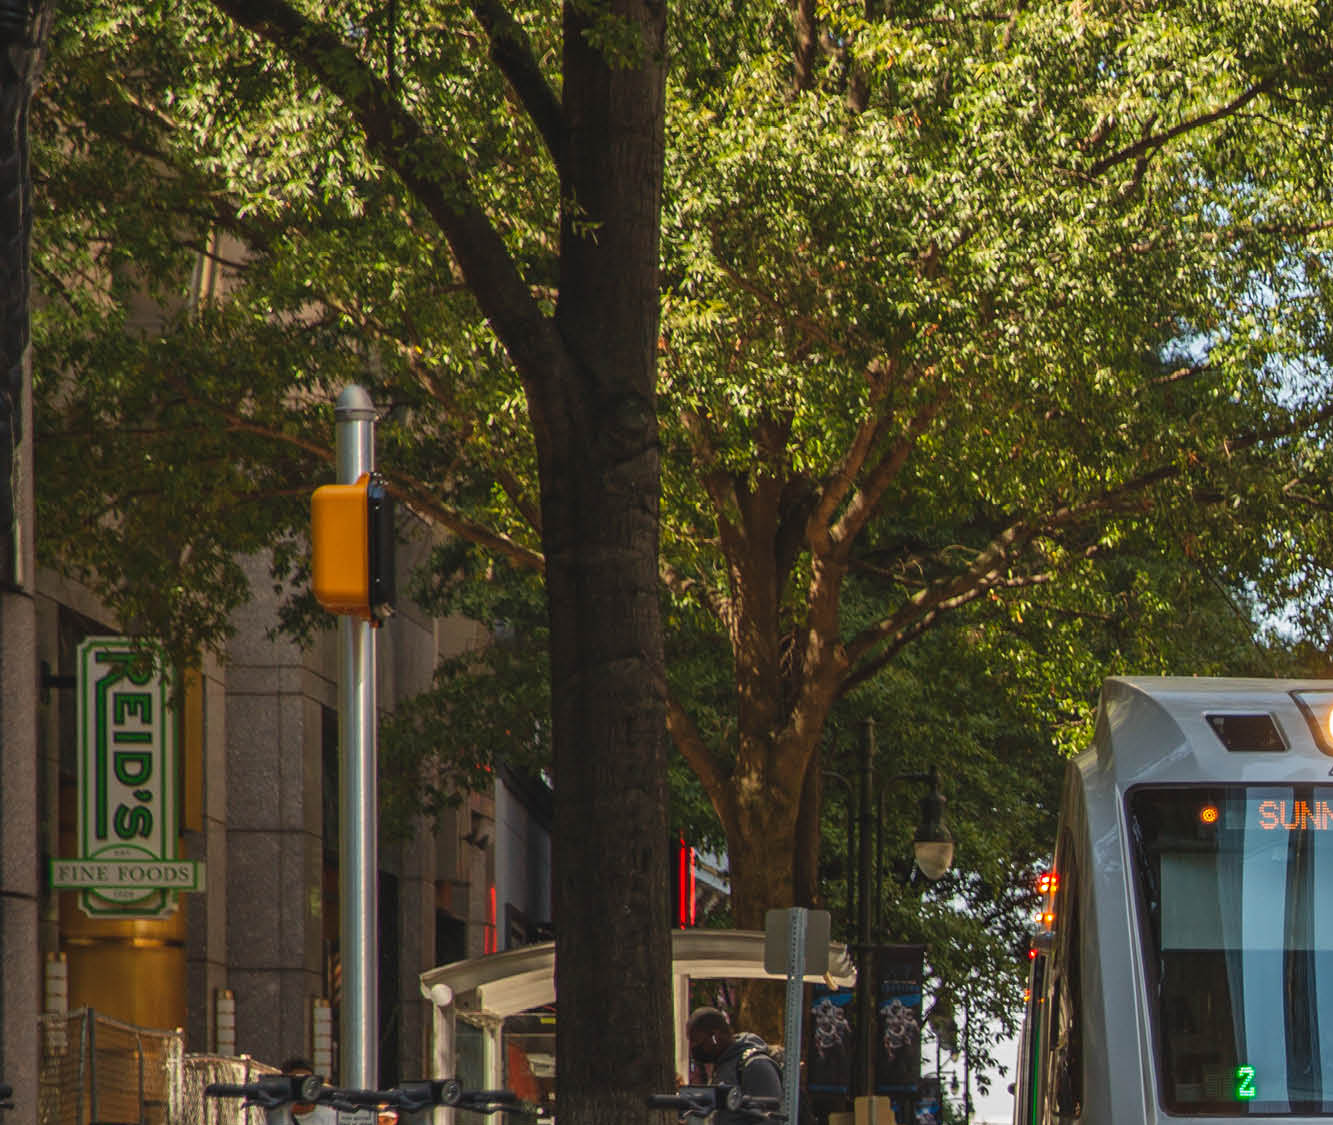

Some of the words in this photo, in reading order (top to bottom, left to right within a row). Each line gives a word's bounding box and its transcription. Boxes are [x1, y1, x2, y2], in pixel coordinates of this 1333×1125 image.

[96, 651, 153, 840] REID'S
[59, 866, 109, 882] FINE
[118, 866, 189, 882] FOODS
[1239, 1066, 1255, 1097] 2
